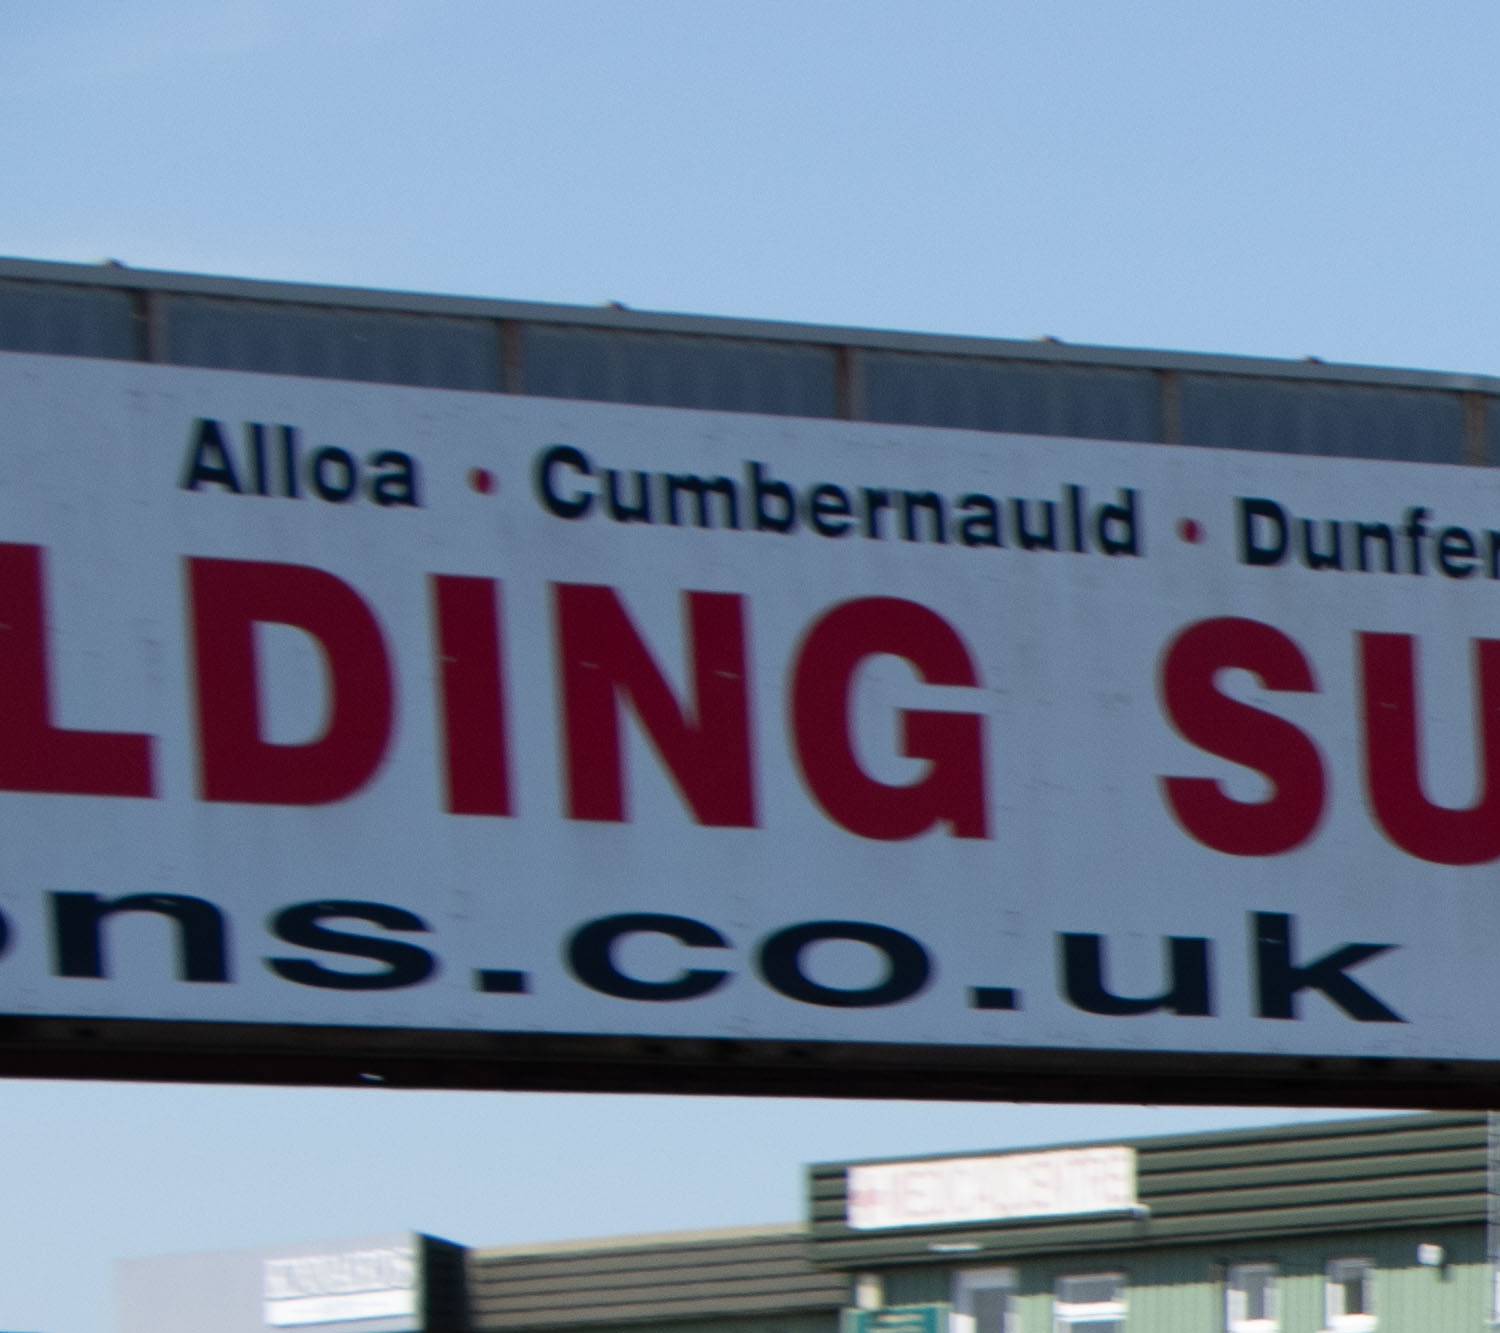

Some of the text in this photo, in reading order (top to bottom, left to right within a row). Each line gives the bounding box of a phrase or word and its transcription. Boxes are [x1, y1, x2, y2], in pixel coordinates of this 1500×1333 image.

[181, 419, 420, 509] Alloa
[534, 444, 1141, 558] Cumbernauld
[0, 545, 990, 840] LDING
[0, 890, 1408, 1023] ns.co.uk
